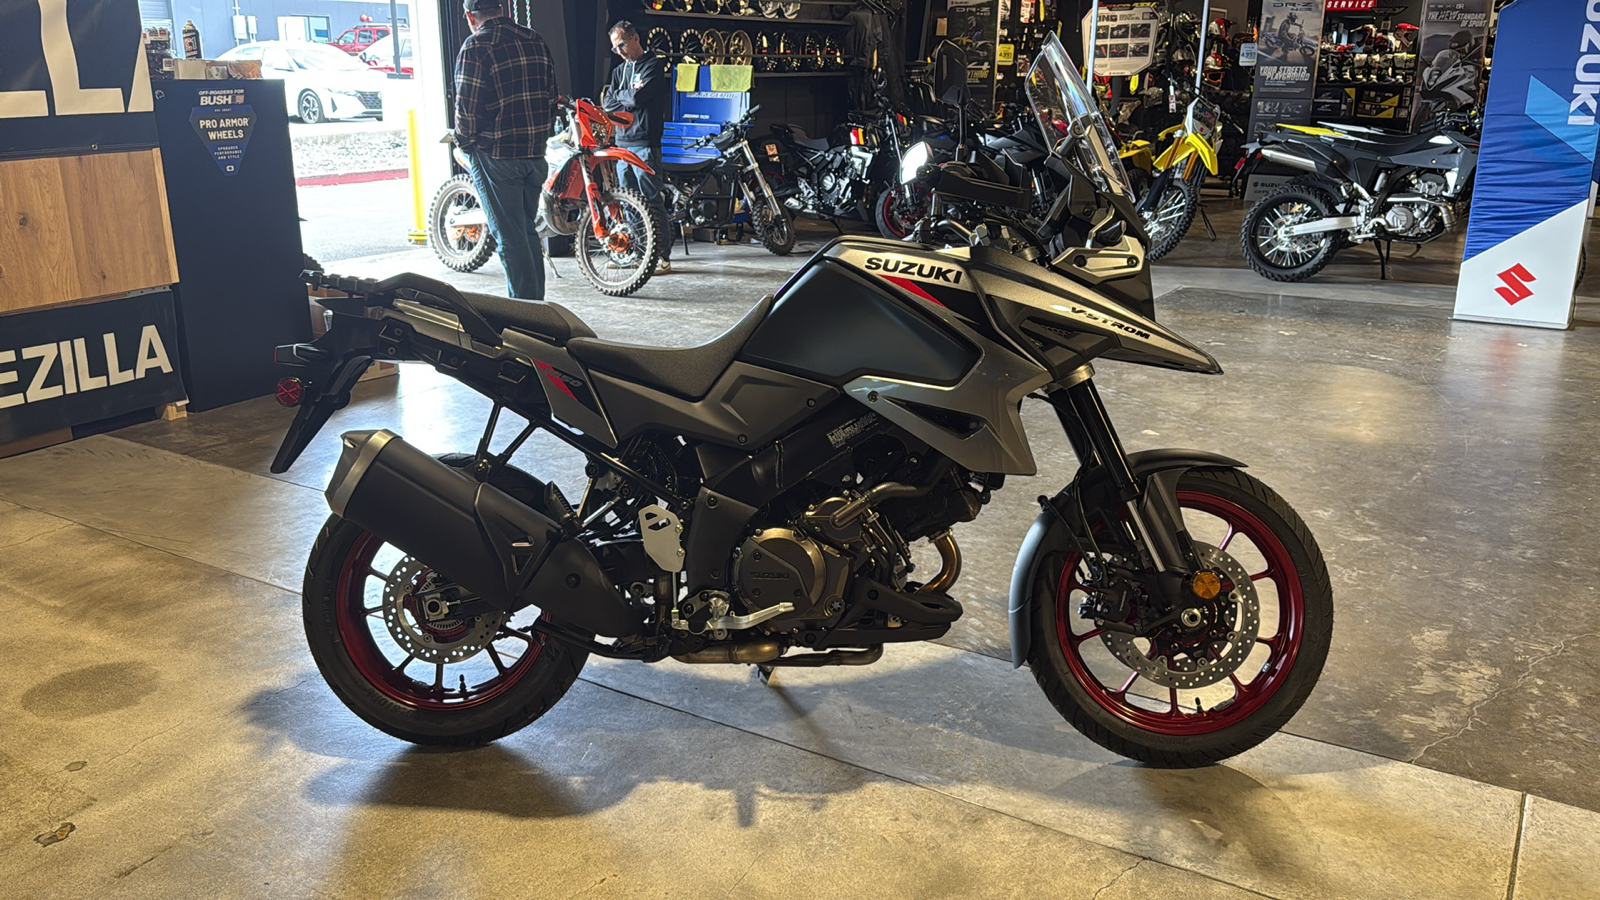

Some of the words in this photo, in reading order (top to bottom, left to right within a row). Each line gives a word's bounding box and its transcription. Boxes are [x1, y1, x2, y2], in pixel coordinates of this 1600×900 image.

[1428, 12, 1439, 20] THE
[1438, 10, 1459, 20] NEW
[1278, 66, 1308, 74] STREETS
[1266, 73, 1310, 81] PLAYGROUND
[200, 95, 232, 106] BUSH
[200, 119, 218, 129] PRO
[220, 118, 249, 128] ARMOR
[208, 130, 244, 140] WHEELS
[864, 257, 963, 285] SUZUKI
[1069, 306, 1151, 340] V-STROM
[750, 572, 790, 580] SUZUKI
